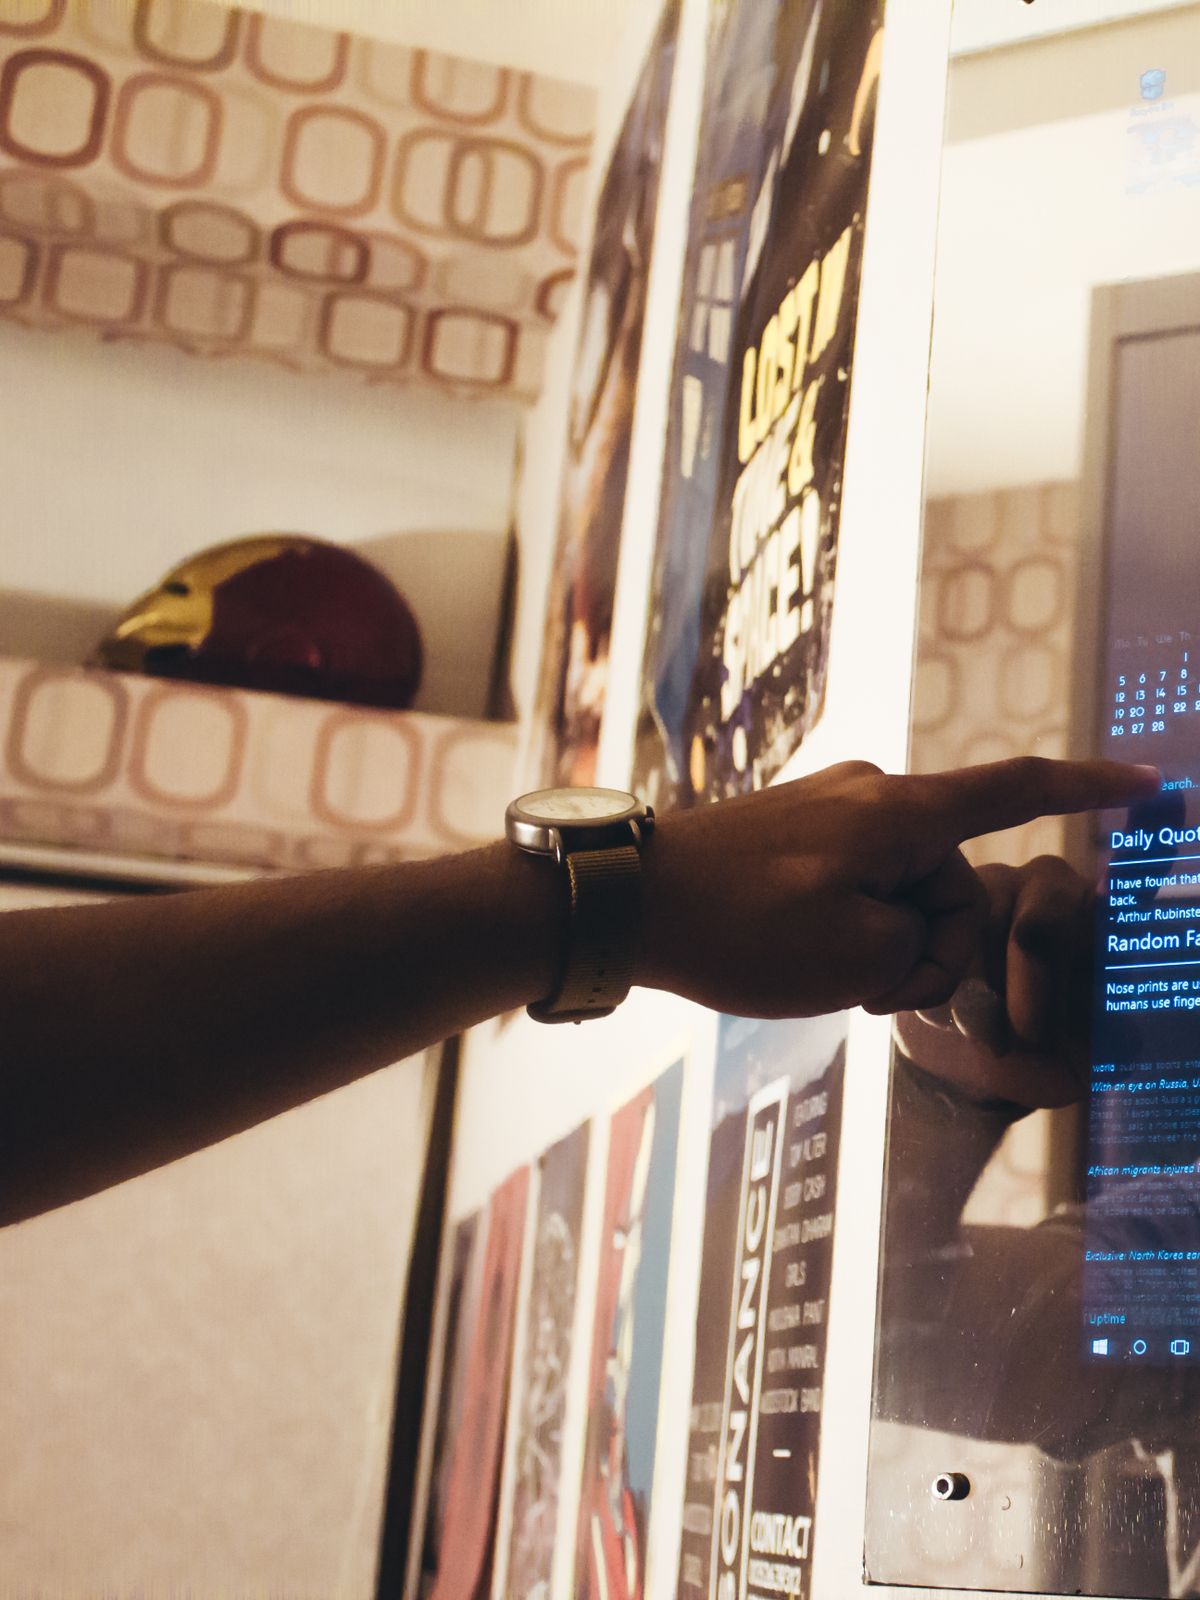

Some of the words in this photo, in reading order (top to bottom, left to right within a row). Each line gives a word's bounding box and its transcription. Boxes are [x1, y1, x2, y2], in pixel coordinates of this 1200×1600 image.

[738, 259, 820, 464] LOST
[1184, 652, 1187, 662] 1
[1120, 676, 1125, 685] 5
[1139, 674, 1145, 684] 6
[1160, 671, 1166, 681] 7
[1181, 669, 1187, 678] 8
[1116, 693, 1125, 702] 12
[1136, 690, 1145, 700] 13
[1156, 688, 1165, 698] 14
[1178, 685, 1187, 695] 15
[1115, 709, 1124, 718] 19
[1130, 707, 1144, 717] 20
[1156, 704, 1165, 714] 21
[1174, 702, 1186, 712] 22
[1112, 726, 1124, 736] 26
[1132, 723, 1144, 733] 27
[1152, 721, 1165, 731] 28
[1111, 830, 1153, 850] Daily
[1110, 880, 1113, 890] I
[1116, 877, 1142, 889] have
[1145, 875, 1176, 887] found
[1110, 894, 1137, 906] back.
[1117, 911, 1151, 923] Arthur
[1108, 932, 1180, 952] Random
[1107, 983, 1134, 994] Nose
[1138, 980, 1168, 996] prints
[1172, 981, 1189, 991] are
[1106, 999, 1148, 1011] humans
[1152, 998, 1170, 1008] use
[1092, 1064, 1115, 1072] world
[1091, 1082, 1112, 1092] With
[1128, 1082, 1143, 1092] eye
[1145, 1082, 1156, 1090] on
[1088, 1166, 1119, 1177] African
[1122, 1165, 1160, 1177] migrants
[1164, 1164, 1194, 1176] injured
[1086, 1250, 1126, 1260] Exclusive:
[1130, 1251, 1155, 1260] North
[1158, 1250, 1183, 1260] Korea
[1090, 1312, 1126, 1326] Uptime
[751, 1511, 812, 1559] CONTACT
